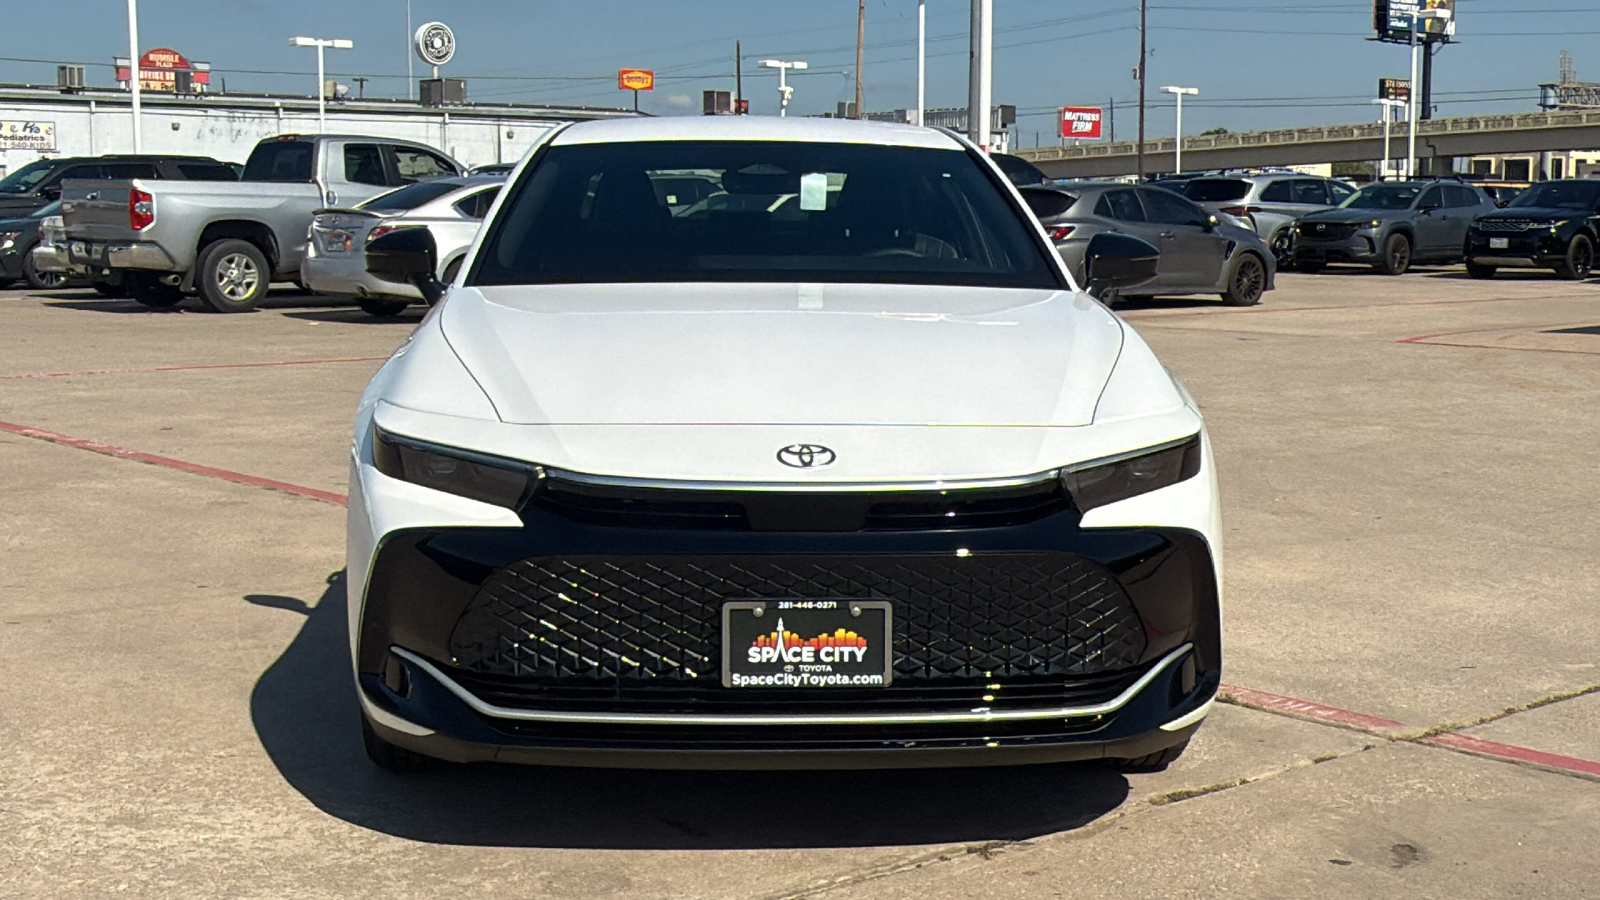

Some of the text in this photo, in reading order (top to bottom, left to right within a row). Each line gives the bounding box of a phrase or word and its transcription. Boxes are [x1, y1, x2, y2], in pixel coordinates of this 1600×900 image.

[1064, 111, 1100, 121] MATTRESS
[1072, 121, 1093, 132] FIRM
[778, 601, 837, 609] 281-446-0271
[747, 646, 868, 663] SPACE CITY
[798, 664, 832, 672] TOYOTA
[732, 673, 883, 687] SpaceCityToyota.com
